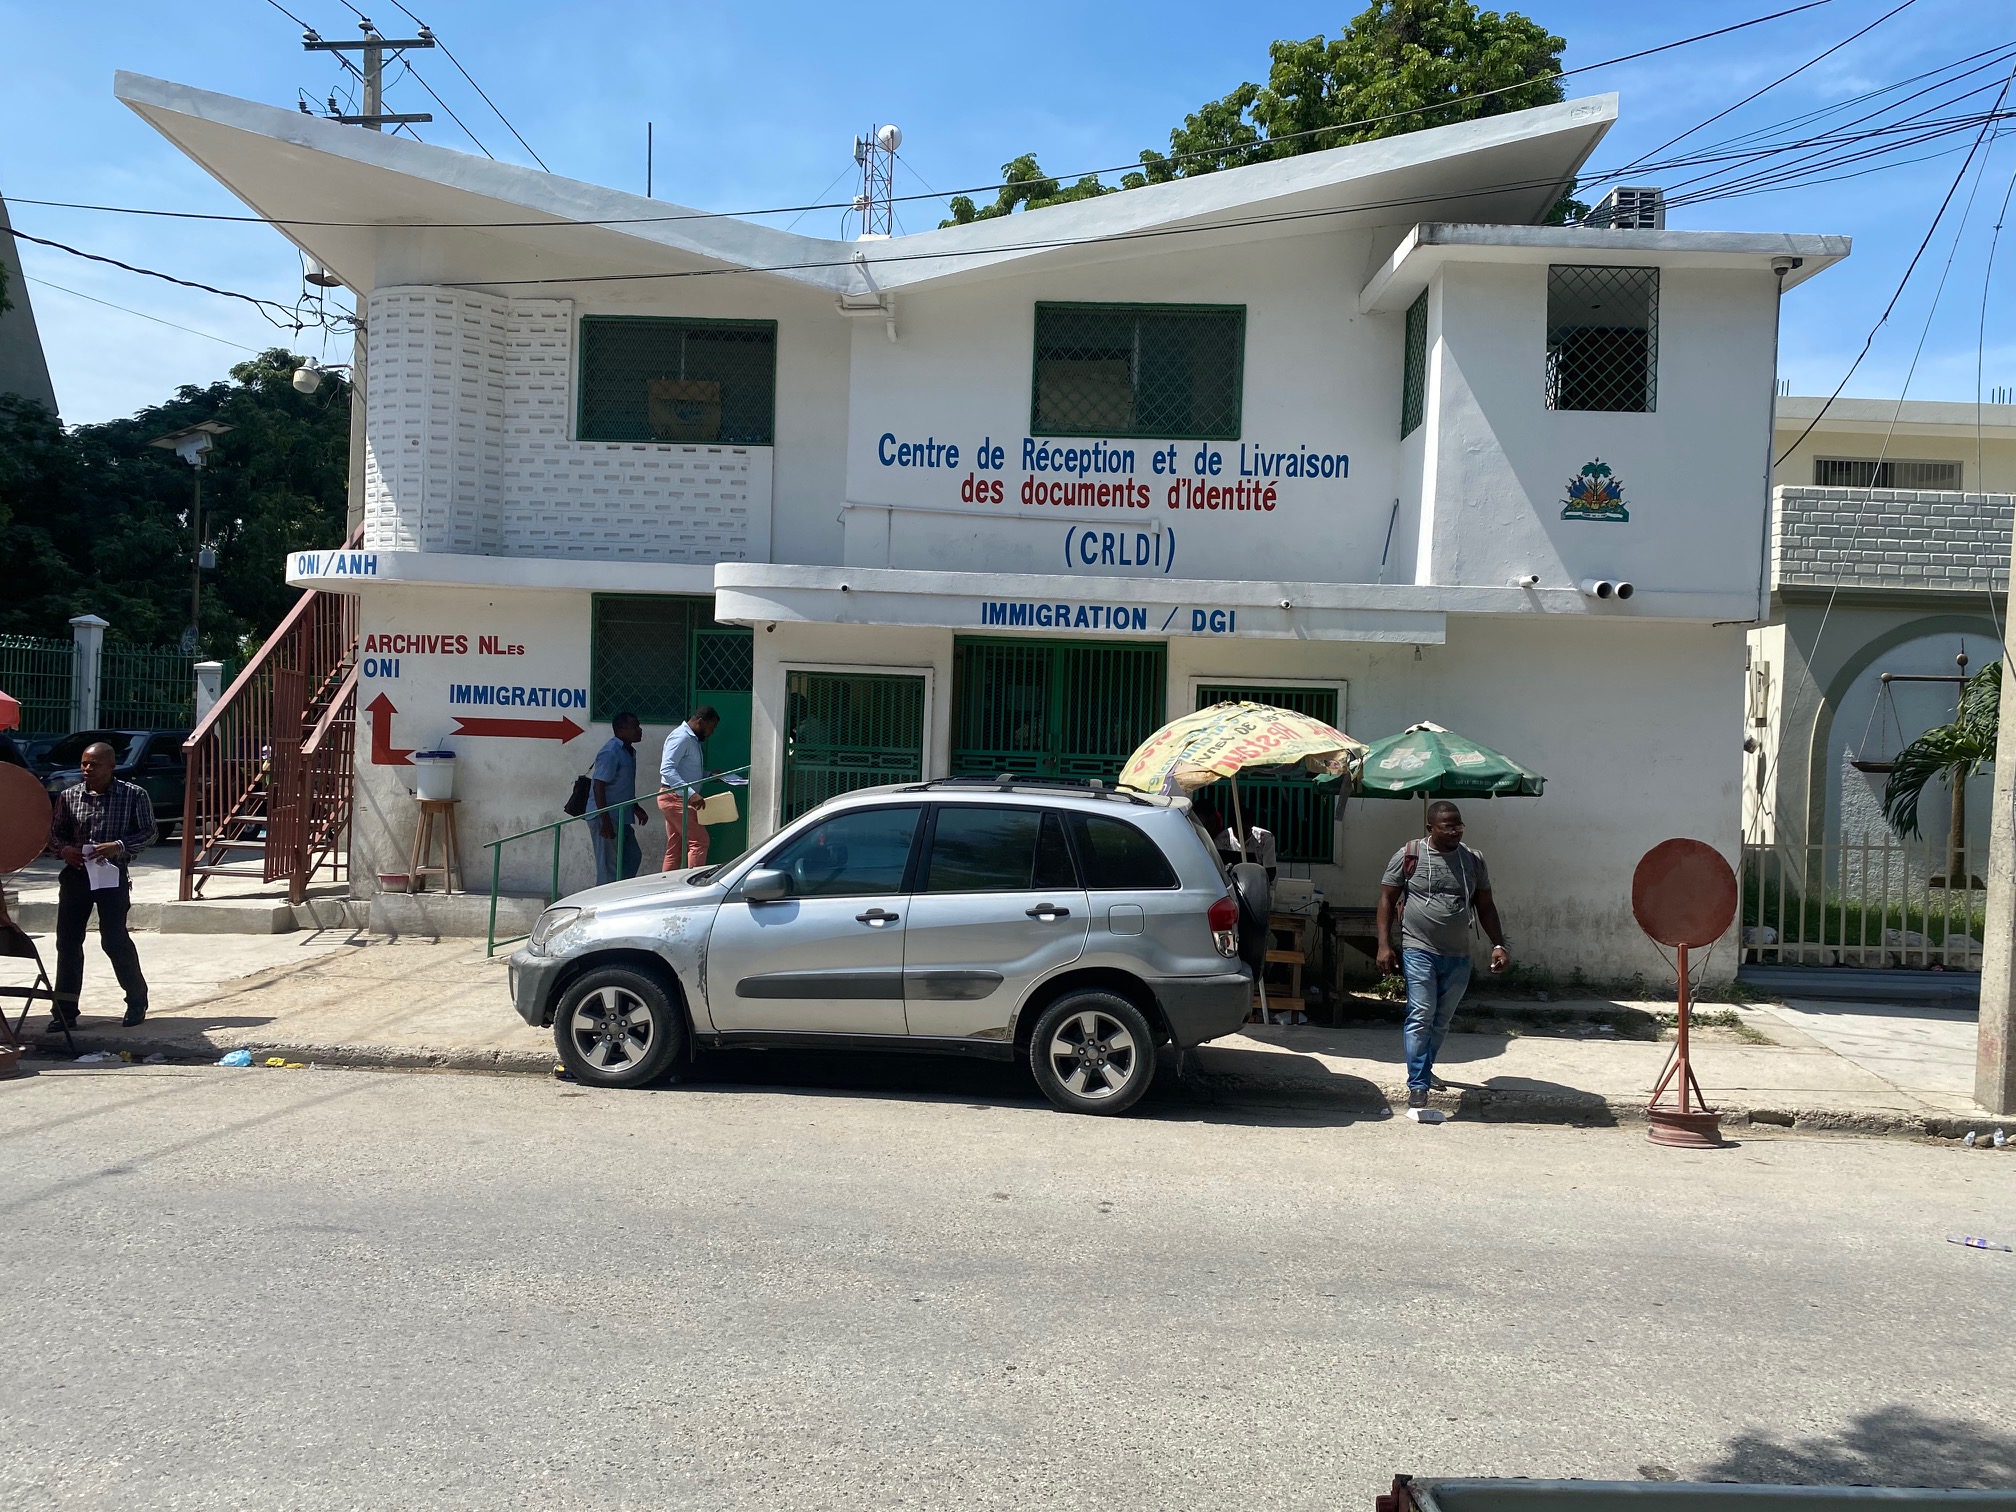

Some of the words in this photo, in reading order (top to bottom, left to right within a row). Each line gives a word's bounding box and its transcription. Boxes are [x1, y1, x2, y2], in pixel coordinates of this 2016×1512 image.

[877, 432, 960, 469] Centre
[976, 437, 1006, 470] de
[1022, 439, 1135, 479] Réception
[1152, 443, 1178, 476] et
[1193, 442, 1223, 476] de
[1239, 443, 1350, 479] Livraison
[961, 472, 1005, 504] des
[1021, 474, 1151, 509] documents
[1167, 477, 1279, 511] d'Identité
[1064, 525, 1176, 573] (CRLDI)
[981, 602, 1147, 631] IMMIGRATION
[1191, 609, 1236, 633] DGI
[364, 633, 468, 655] ARCHIVES
[363, 658, 400, 678] ONI
[449, 684, 587, 709] IMMIGRATION
